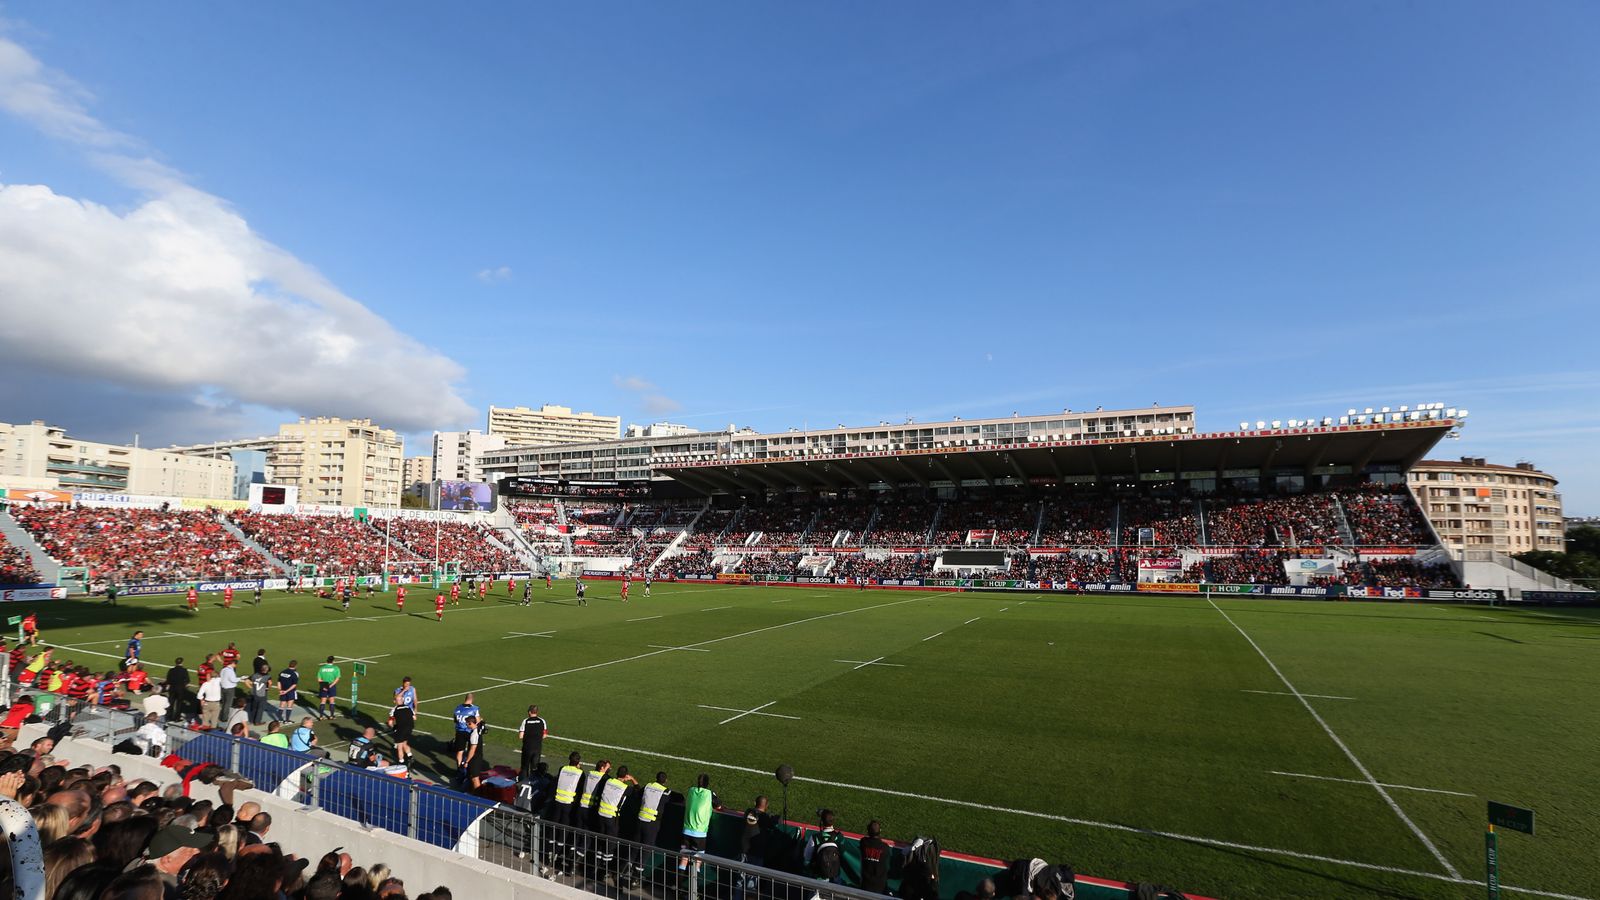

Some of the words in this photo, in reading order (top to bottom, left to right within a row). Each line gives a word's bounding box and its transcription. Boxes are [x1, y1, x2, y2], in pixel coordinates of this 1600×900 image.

[381, 509, 406, 518] VILLE
[409, 510, 421, 519] DE
[424, 511, 458, 520] TOULON
[834, 576, 855, 584] FedEx
[1026, 580, 1051, 589] FedEx
[129, 585, 174, 595] CARDIFF
[1052, 581, 1078, 590] FedEx
[1110, 583, 1131, 591] amlin
[1301, 586, 1327, 595] amlin
[1347, 586, 1382, 598] FedEx
[1384, 586, 1421, 598] FedEx
[1455, 590, 1497, 599] adidas
